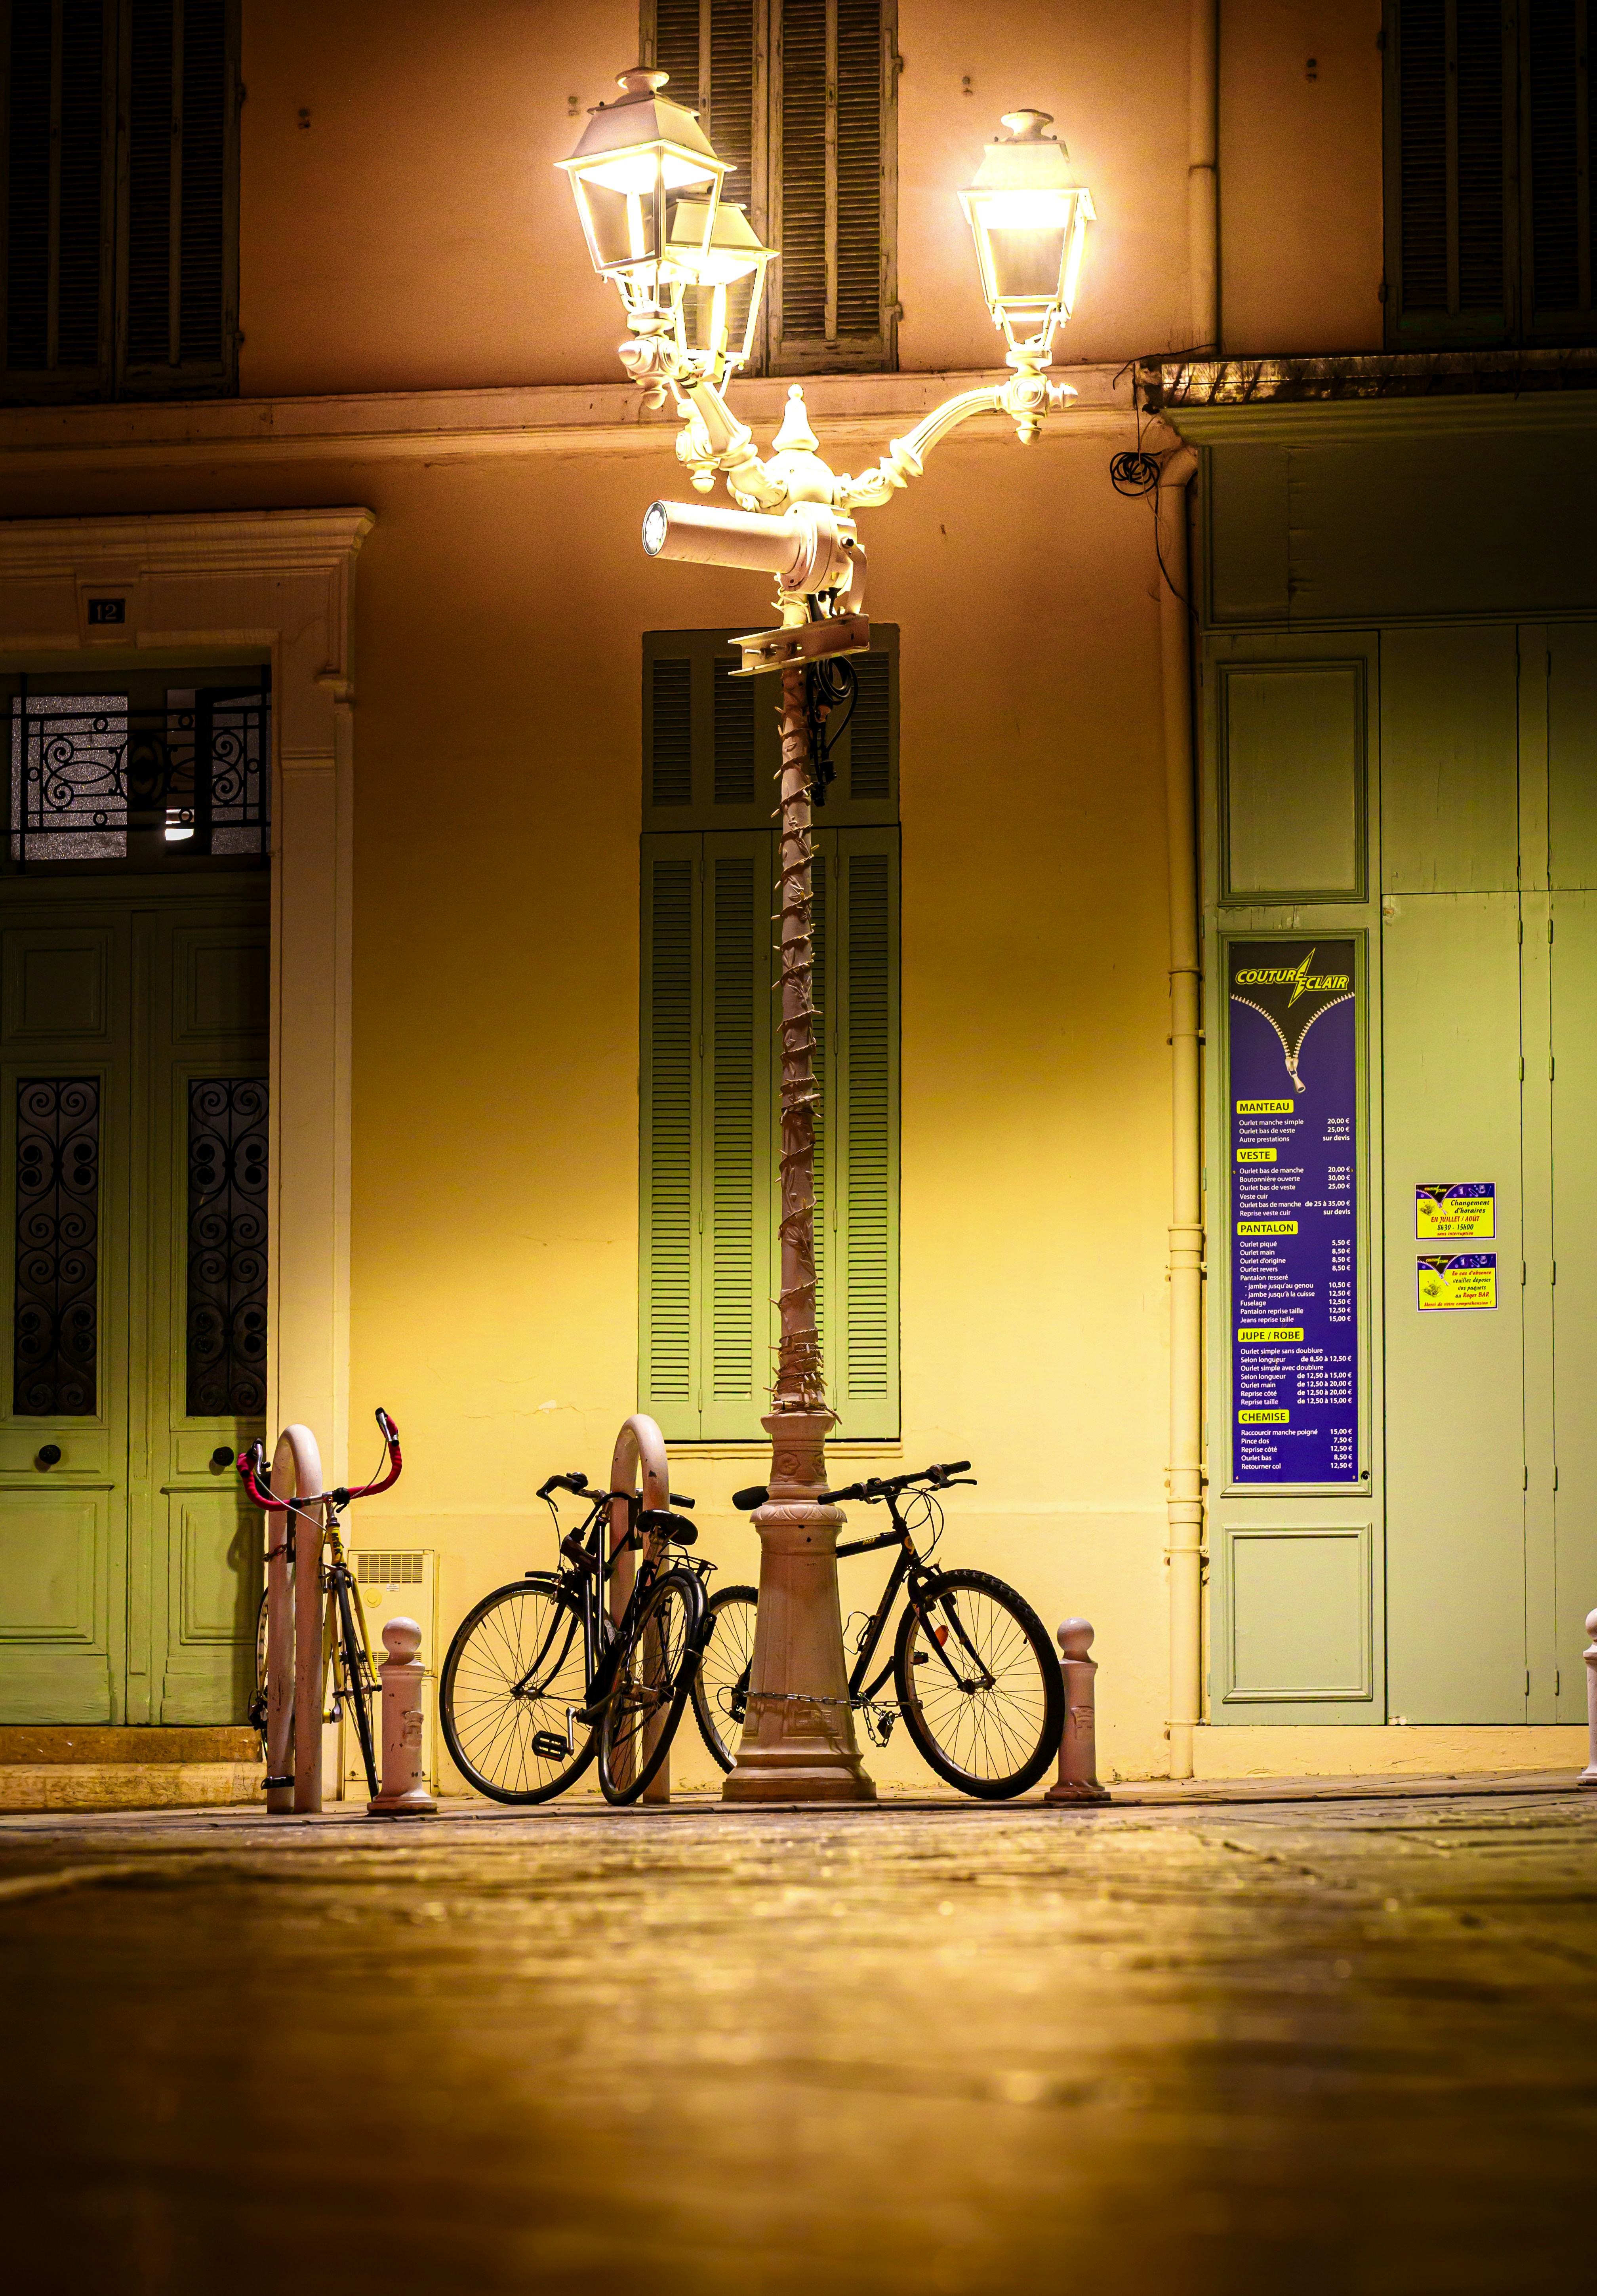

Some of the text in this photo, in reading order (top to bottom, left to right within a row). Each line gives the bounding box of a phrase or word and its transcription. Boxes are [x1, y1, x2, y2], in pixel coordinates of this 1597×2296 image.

[97, 604, 117, 621] 12
[1237, 969, 1347, 989] COUTURE ECLAIR
[1239, 1102, 1289, 1112] MANTEAU
[1240, 1151, 1270, 1159] VESTE
[1241, 1224, 1294, 1233] PANTALON
[1241, 1332, 1265, 1340] JUPE
[331, 1533, 342, 1556] MBK
